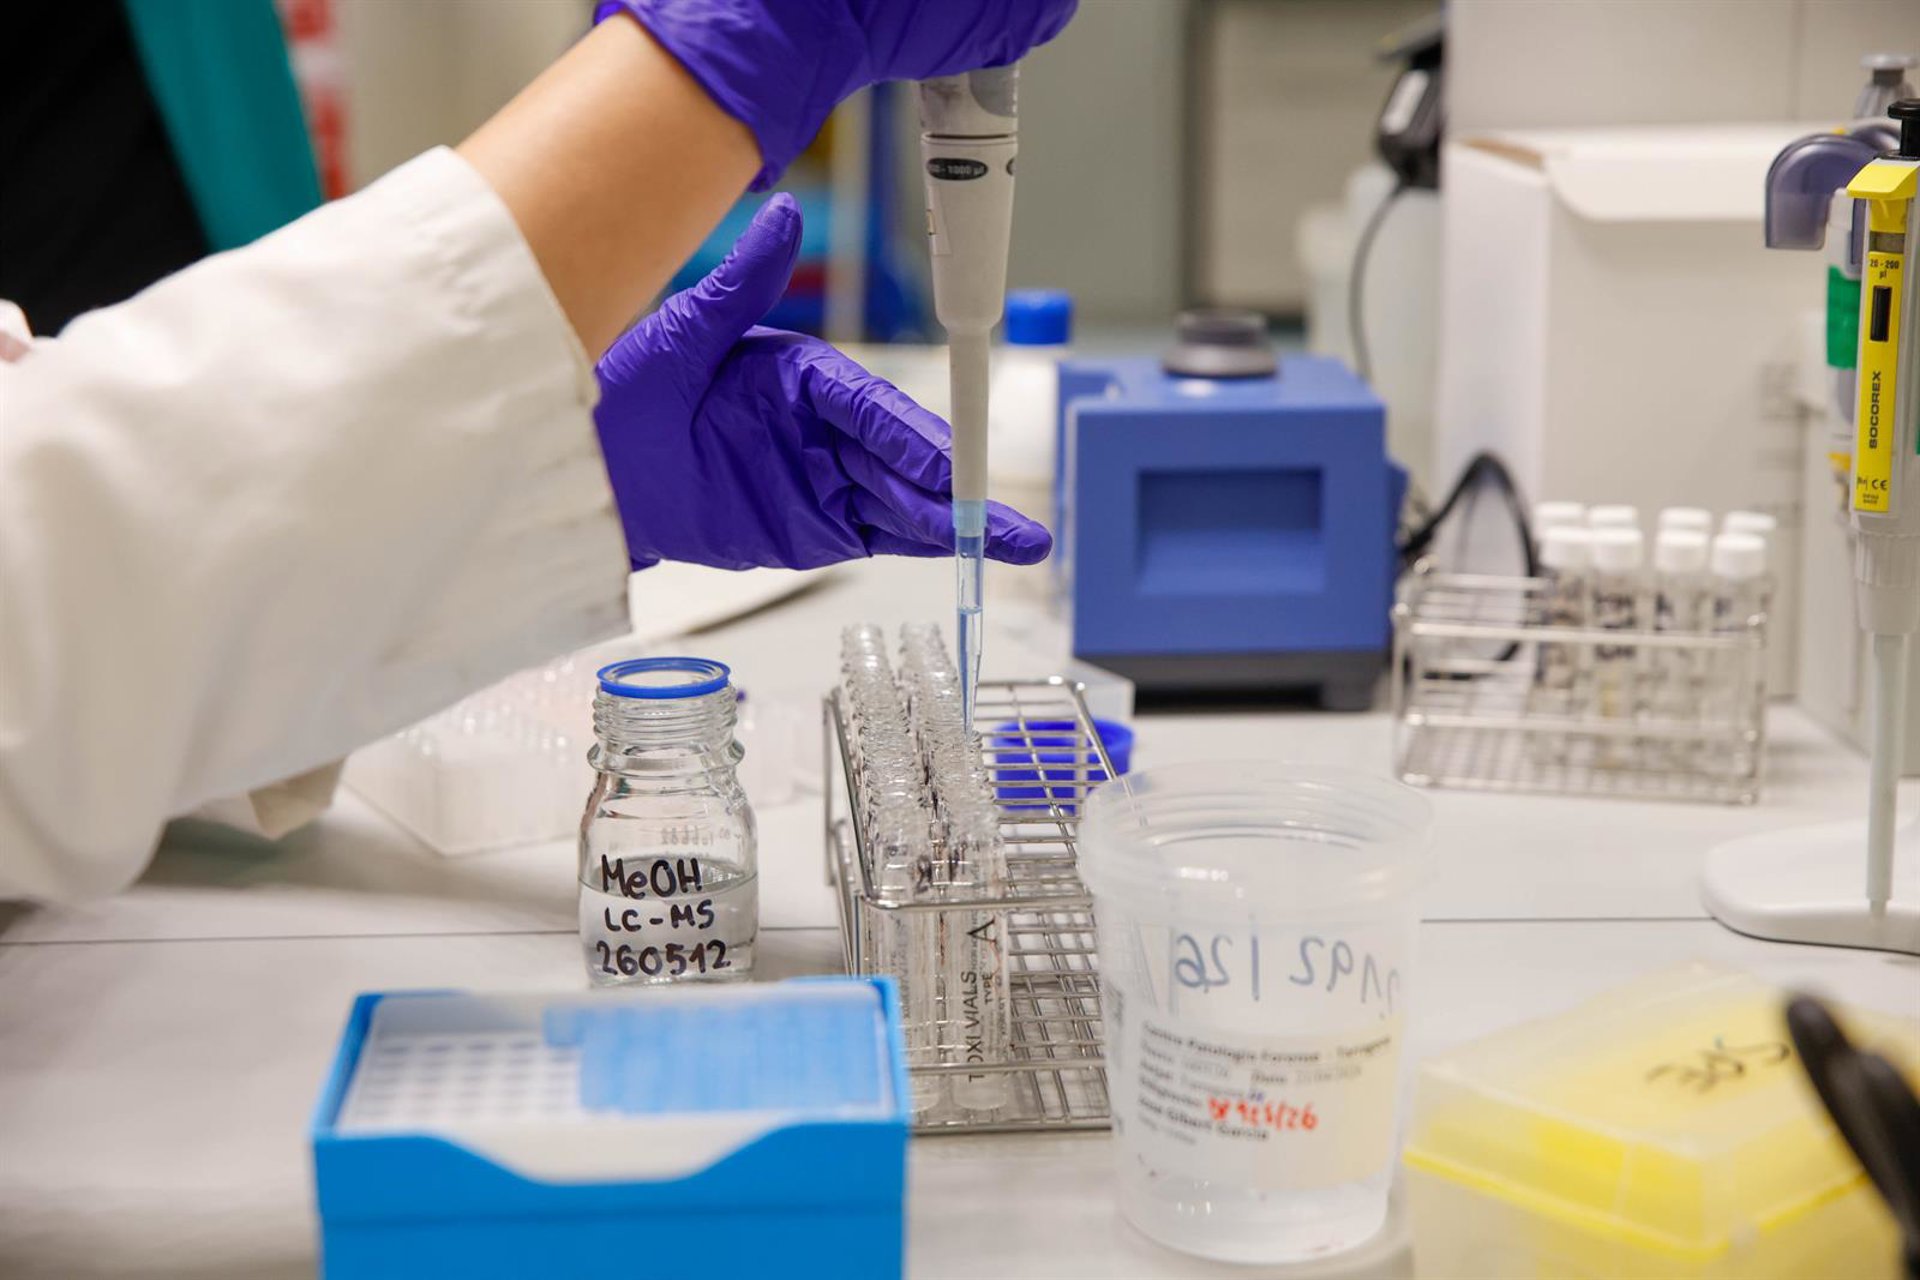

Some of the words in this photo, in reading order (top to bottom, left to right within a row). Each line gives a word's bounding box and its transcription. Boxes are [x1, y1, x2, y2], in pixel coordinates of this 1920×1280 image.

[1869, 371, 1882, 449] SOCOREX
[602, 854, 703, 899] MeOH
[966, 918, 998, 944] A
[596, 939, 732, 976] 260512
[961, 970, 981, 1029] VIALS
[982, 972, 994, 1005] TYPE
